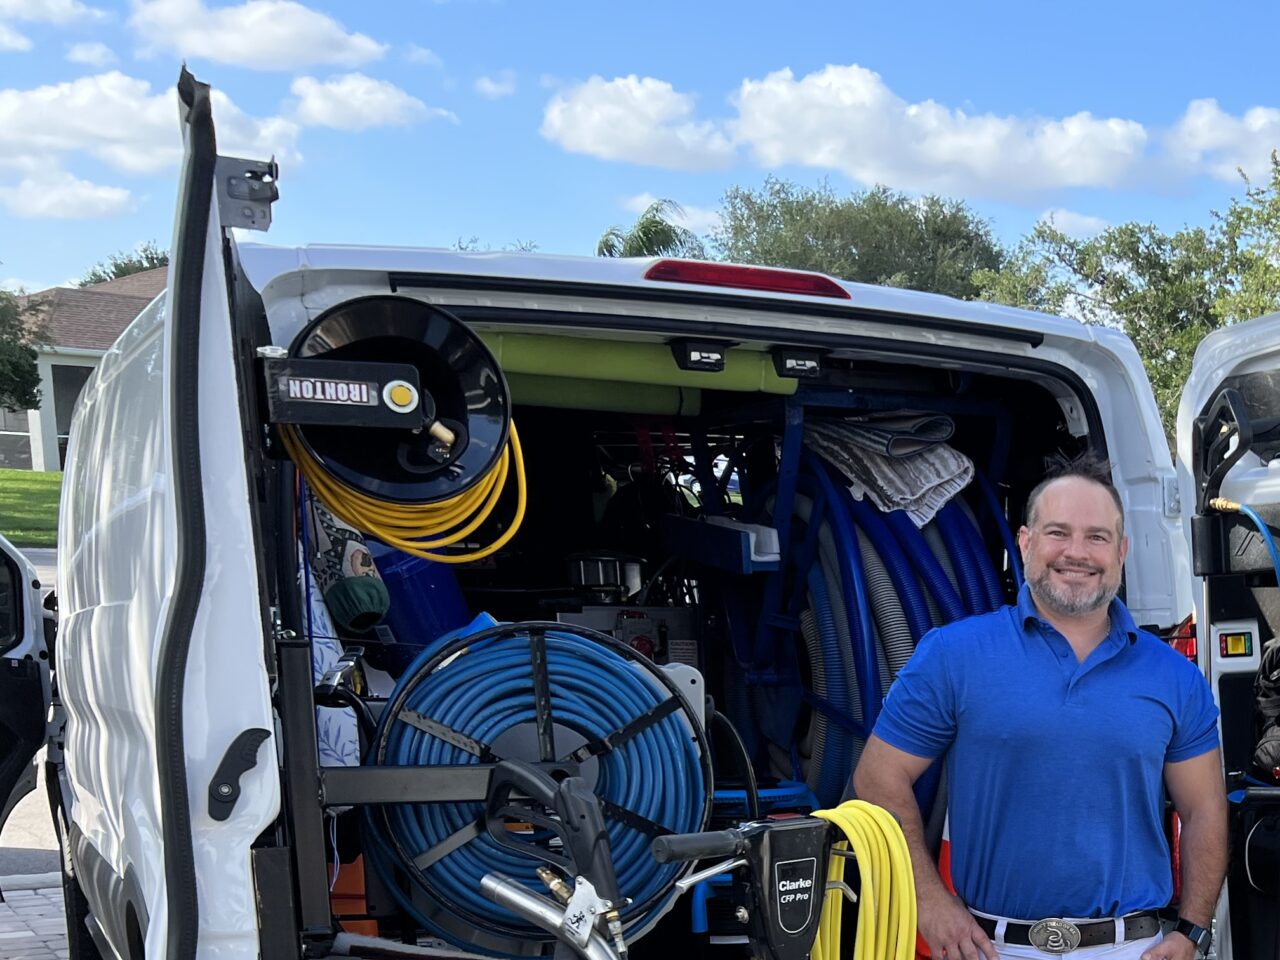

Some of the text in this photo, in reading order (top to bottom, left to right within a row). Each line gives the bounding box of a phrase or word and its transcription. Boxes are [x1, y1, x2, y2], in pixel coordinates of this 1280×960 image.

[288, 379, 368, 402] IRONTON
[779, 878, 812, 891] Clarke
[780, 892, 809, 903] CFP Pro
